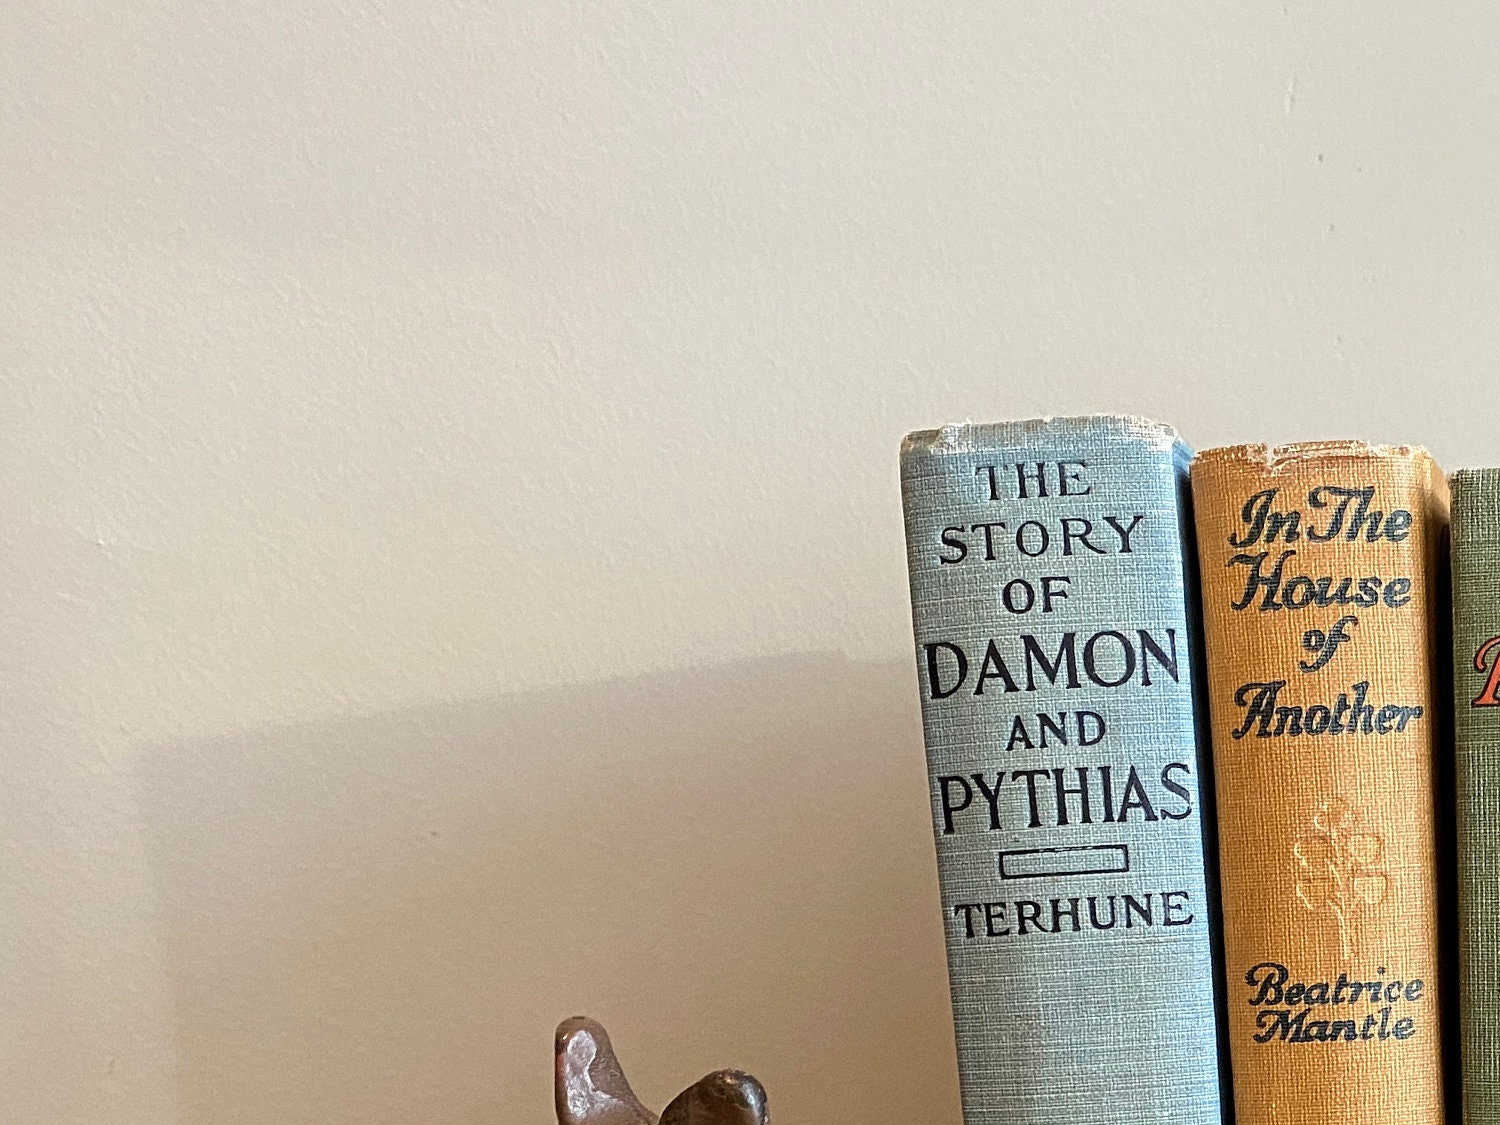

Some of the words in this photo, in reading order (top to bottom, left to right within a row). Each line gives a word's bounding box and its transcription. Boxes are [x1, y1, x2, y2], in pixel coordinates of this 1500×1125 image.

[975, 459, 1091, 501] THE
[940, 515, 1144, 565] STORY
[1228, 486, 1301, 549] In
[1306, 485, 1413, 543] The
[1002, 576, 1072, 615] OF
[1225, 549, 1411, 612] House
[923, 628, 1179, 700] DAMON
[1299, 615, 1358, 673] of
[1005, 710, 1106, 751] AND
[1231, 679, 1423, 740] Another
[938, 762, 1193, 836] PYTHIAS
[954, 891, 1194, 939] TERHUNE
[1244, 961, 1424, 1006] Beatrice
[1253, 1006, 1416, 1044] Mantle
